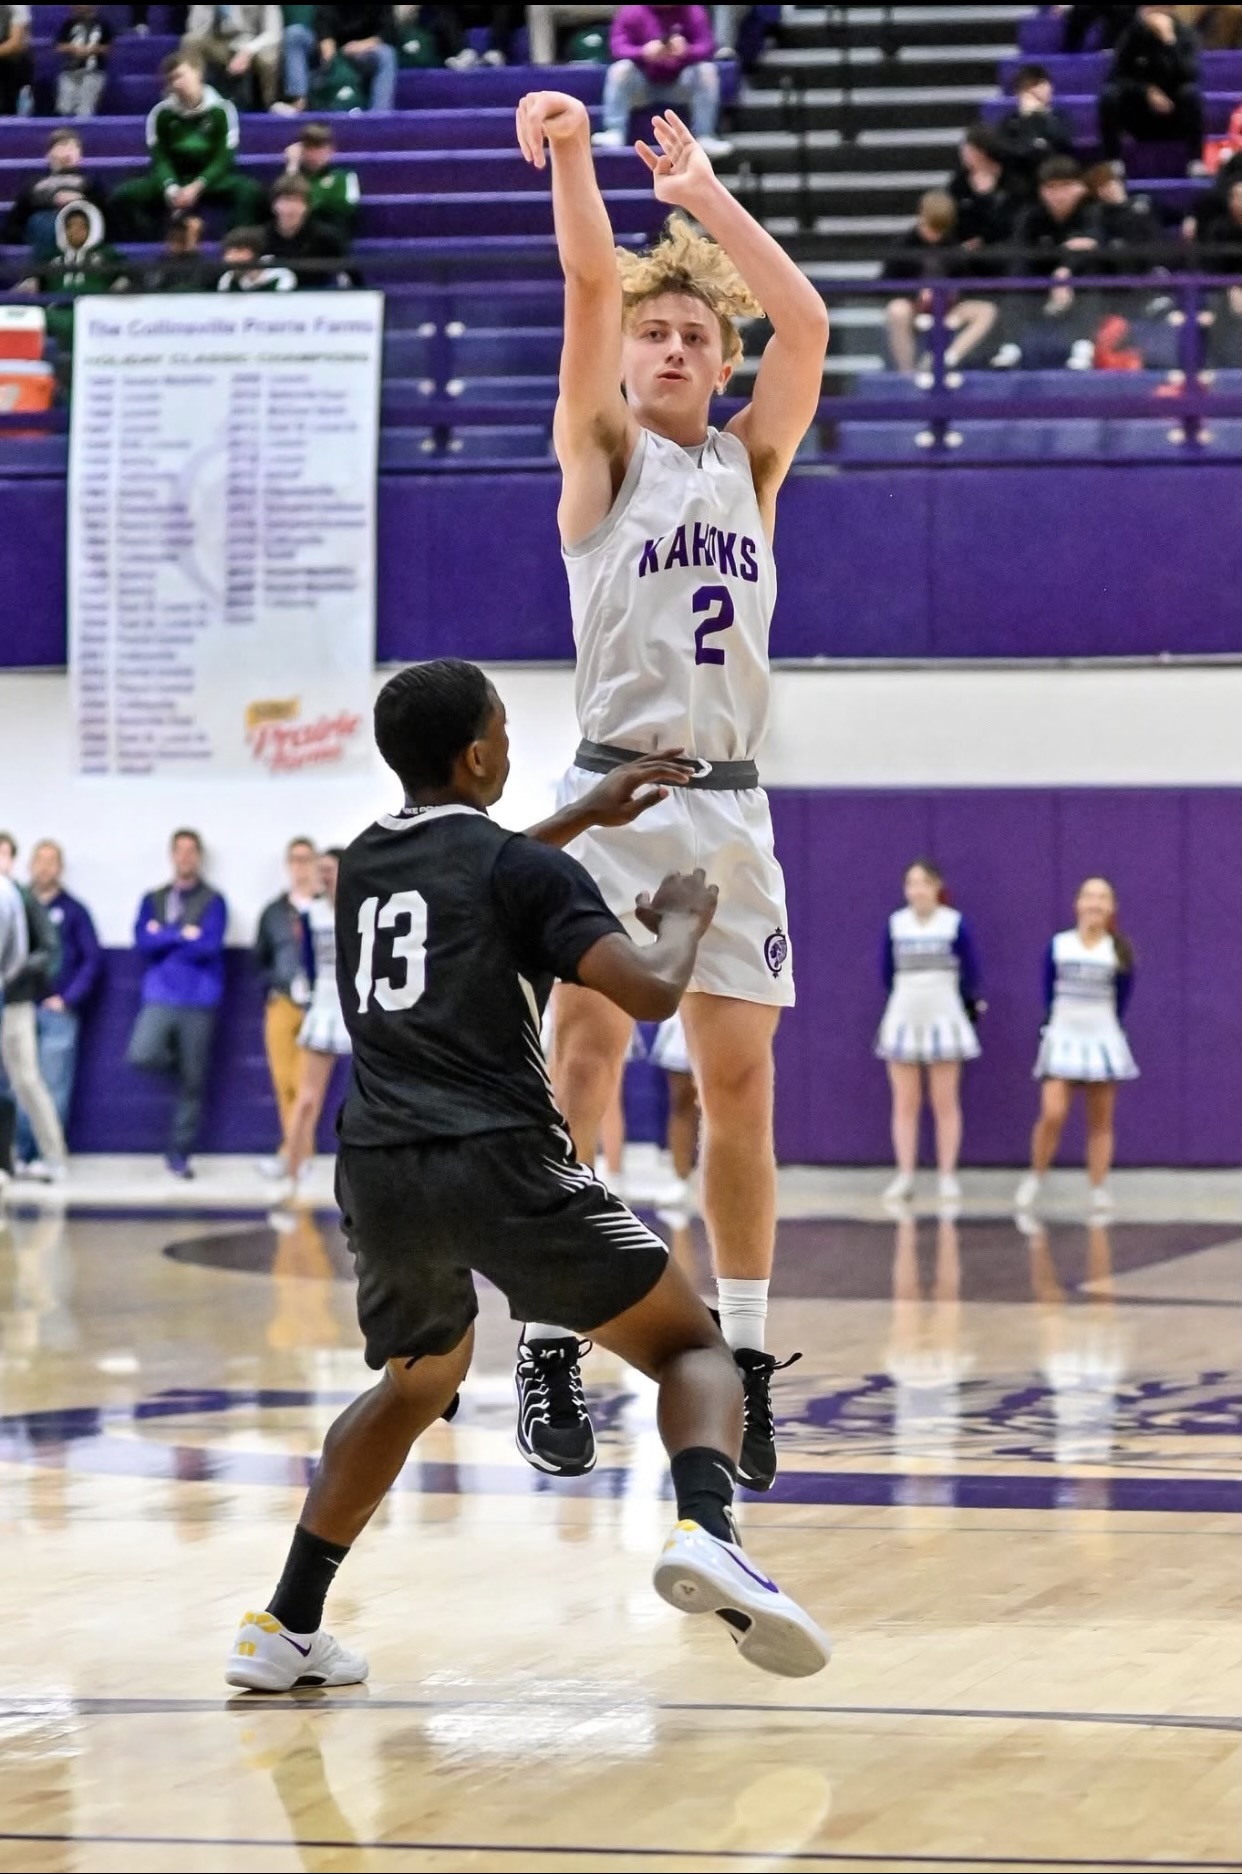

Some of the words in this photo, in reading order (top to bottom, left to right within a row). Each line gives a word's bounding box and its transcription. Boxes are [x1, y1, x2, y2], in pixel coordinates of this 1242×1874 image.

[87, 320, 121, 336] The
[243, 317, 306, 334] Prairie
[313, 316, 377, 333] Farms
[692, 585, 735, 666] 2
[355, 889, 428, 1014] 13
